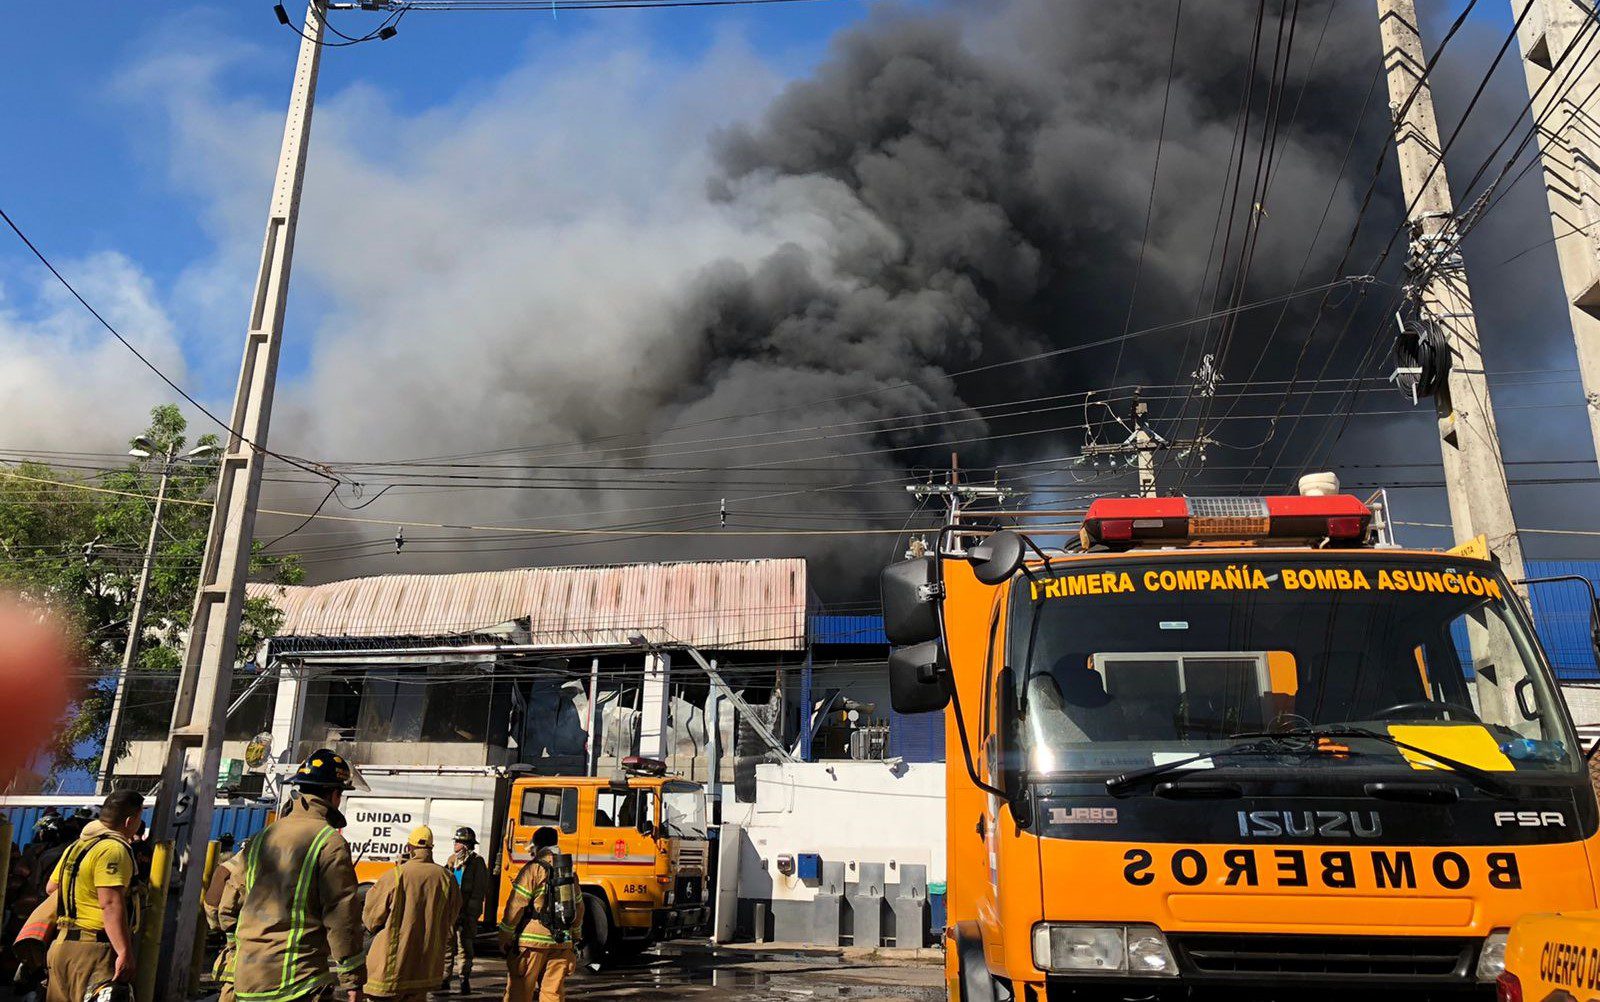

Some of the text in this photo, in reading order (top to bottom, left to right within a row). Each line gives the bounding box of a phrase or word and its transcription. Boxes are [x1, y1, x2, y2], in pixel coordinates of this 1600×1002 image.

[1143, 565, 1270, 591] COMPAÑÍA
[1281, 568, 1371, 590] BOMBA
[1377, 569, 1503, 600] ASUNCIÓN
[355, 812, 412, 824] UNIDAD
[1048, 807, 1118, 821] TURBO
[1493, 811, 1567, 827] FSR
[372, 826, 392, 837] DE
[1237, 810, 1384, 838] ISUZU
[1540, 941, 1587, 989] CUERPO
